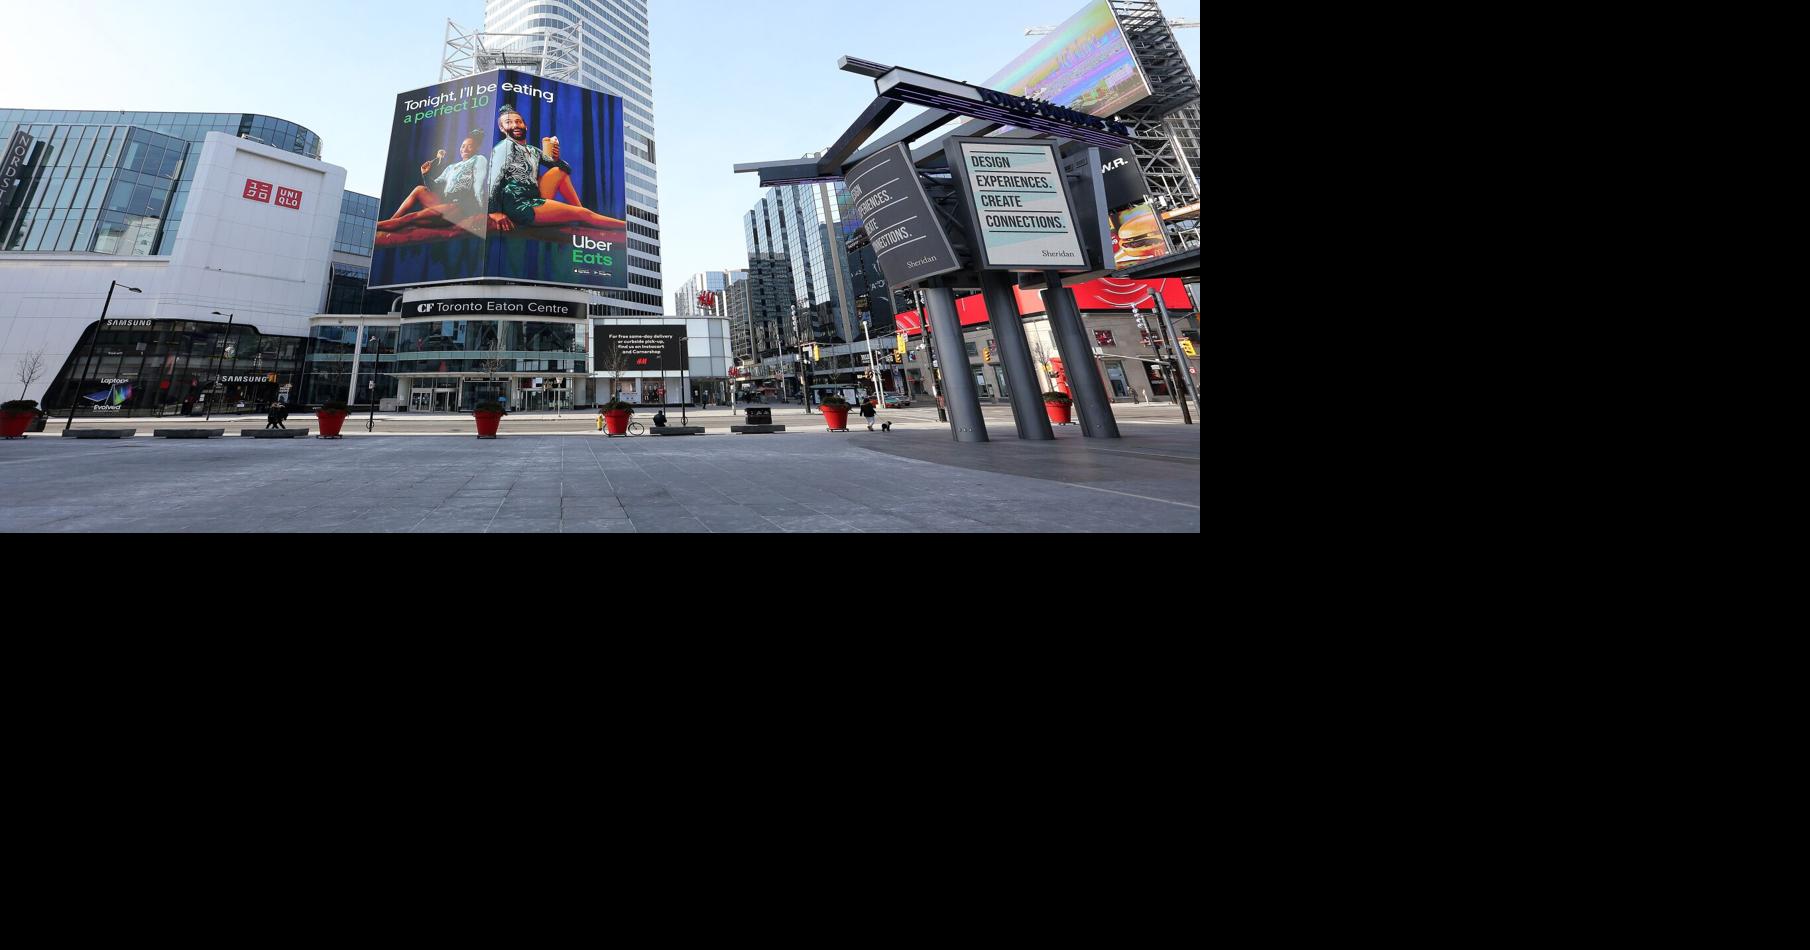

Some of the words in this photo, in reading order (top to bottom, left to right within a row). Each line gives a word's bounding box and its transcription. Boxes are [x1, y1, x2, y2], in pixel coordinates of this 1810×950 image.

[404, 92, 457, 111] Tonight,
[476, 83, 497, 95] be
[501, 82, 554, 103] eating
[403, 113, 412, 124] a
[414, 102, 468, 123] perfect
[471, 96, 489, 109] 10
[970, 155, 1011, 168] DESIGN
[975, 174, 1053, 189] EXPERIENCES.
[980, 194, 1023, 208] CREATE
[985, 214, 1066, 229] CONNECTIONS.
[572, 234, 613, 251] Uber
[572, 249, 613, 266] Eats
[1041, 249, 1075, 258] Sheridan
[906, 255, 937, 269] Sheridan
[417, 303, 435, 313] CF
[437, 302, 483, 312] Toronto
[487, 302, 524, 312] Eaton
[527, 302, 569, 314] Centre
[100, 377, 129, 385] Laptops
[221, 375, 268, 383] SAMSUNG
